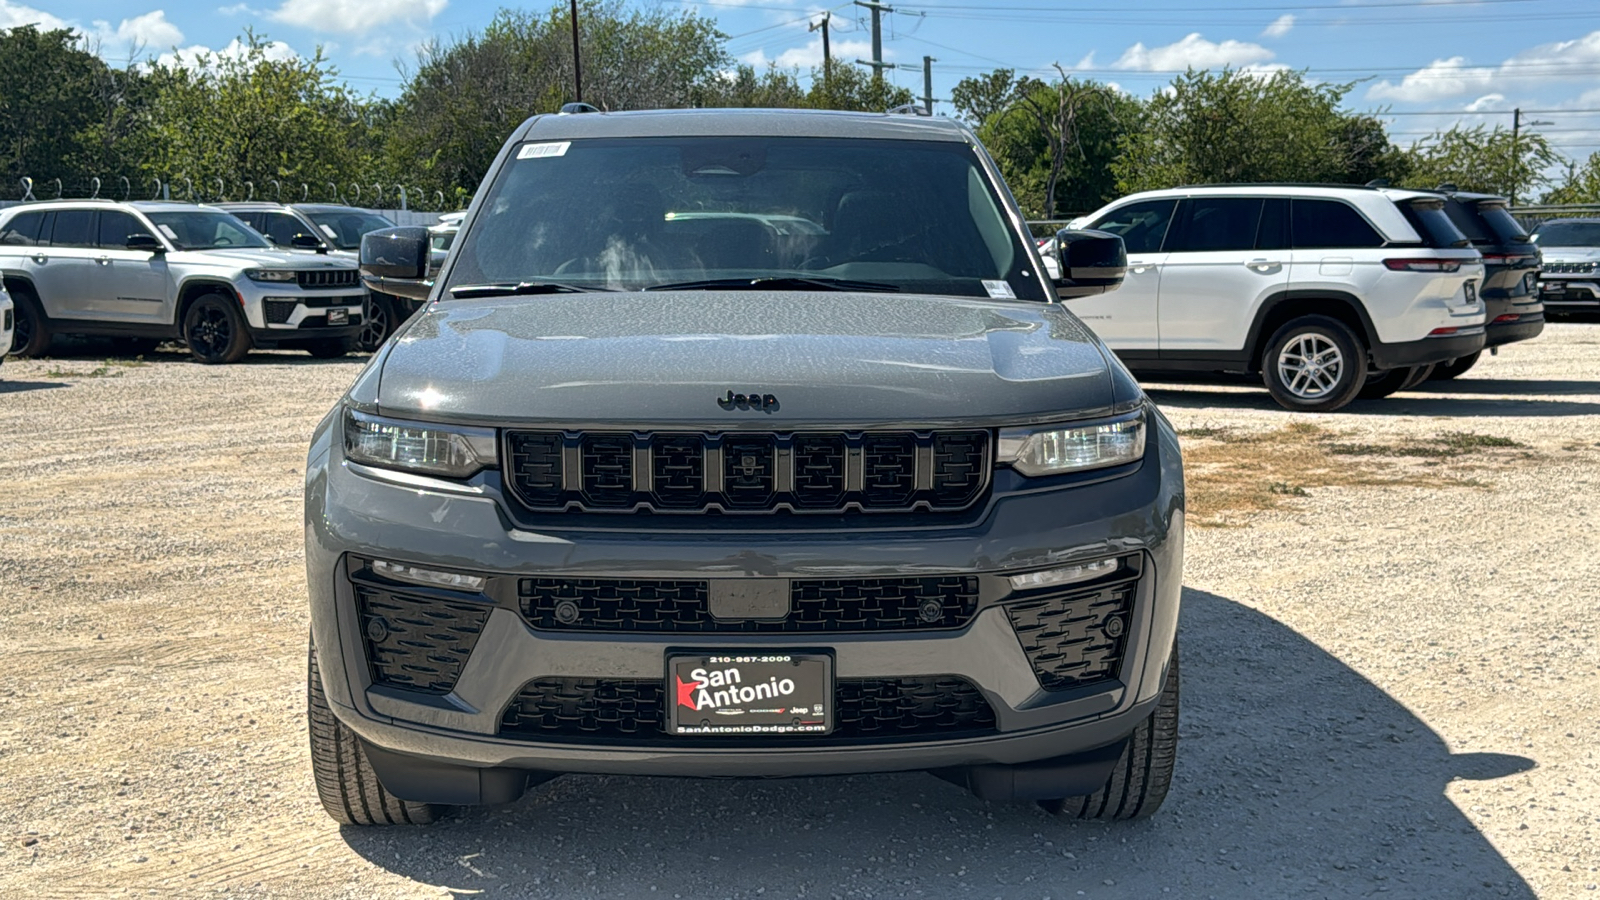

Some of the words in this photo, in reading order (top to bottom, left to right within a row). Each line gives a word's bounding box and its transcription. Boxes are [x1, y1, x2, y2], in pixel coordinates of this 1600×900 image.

[717, 389, 780, 414] Jeep
[690, 667, 742, 690] San
[696, 676, 795, 711] Antonio
[789, 706, 809, 715] Jeep
[676, 725, 826, 734] SanAntonioDodge.com
